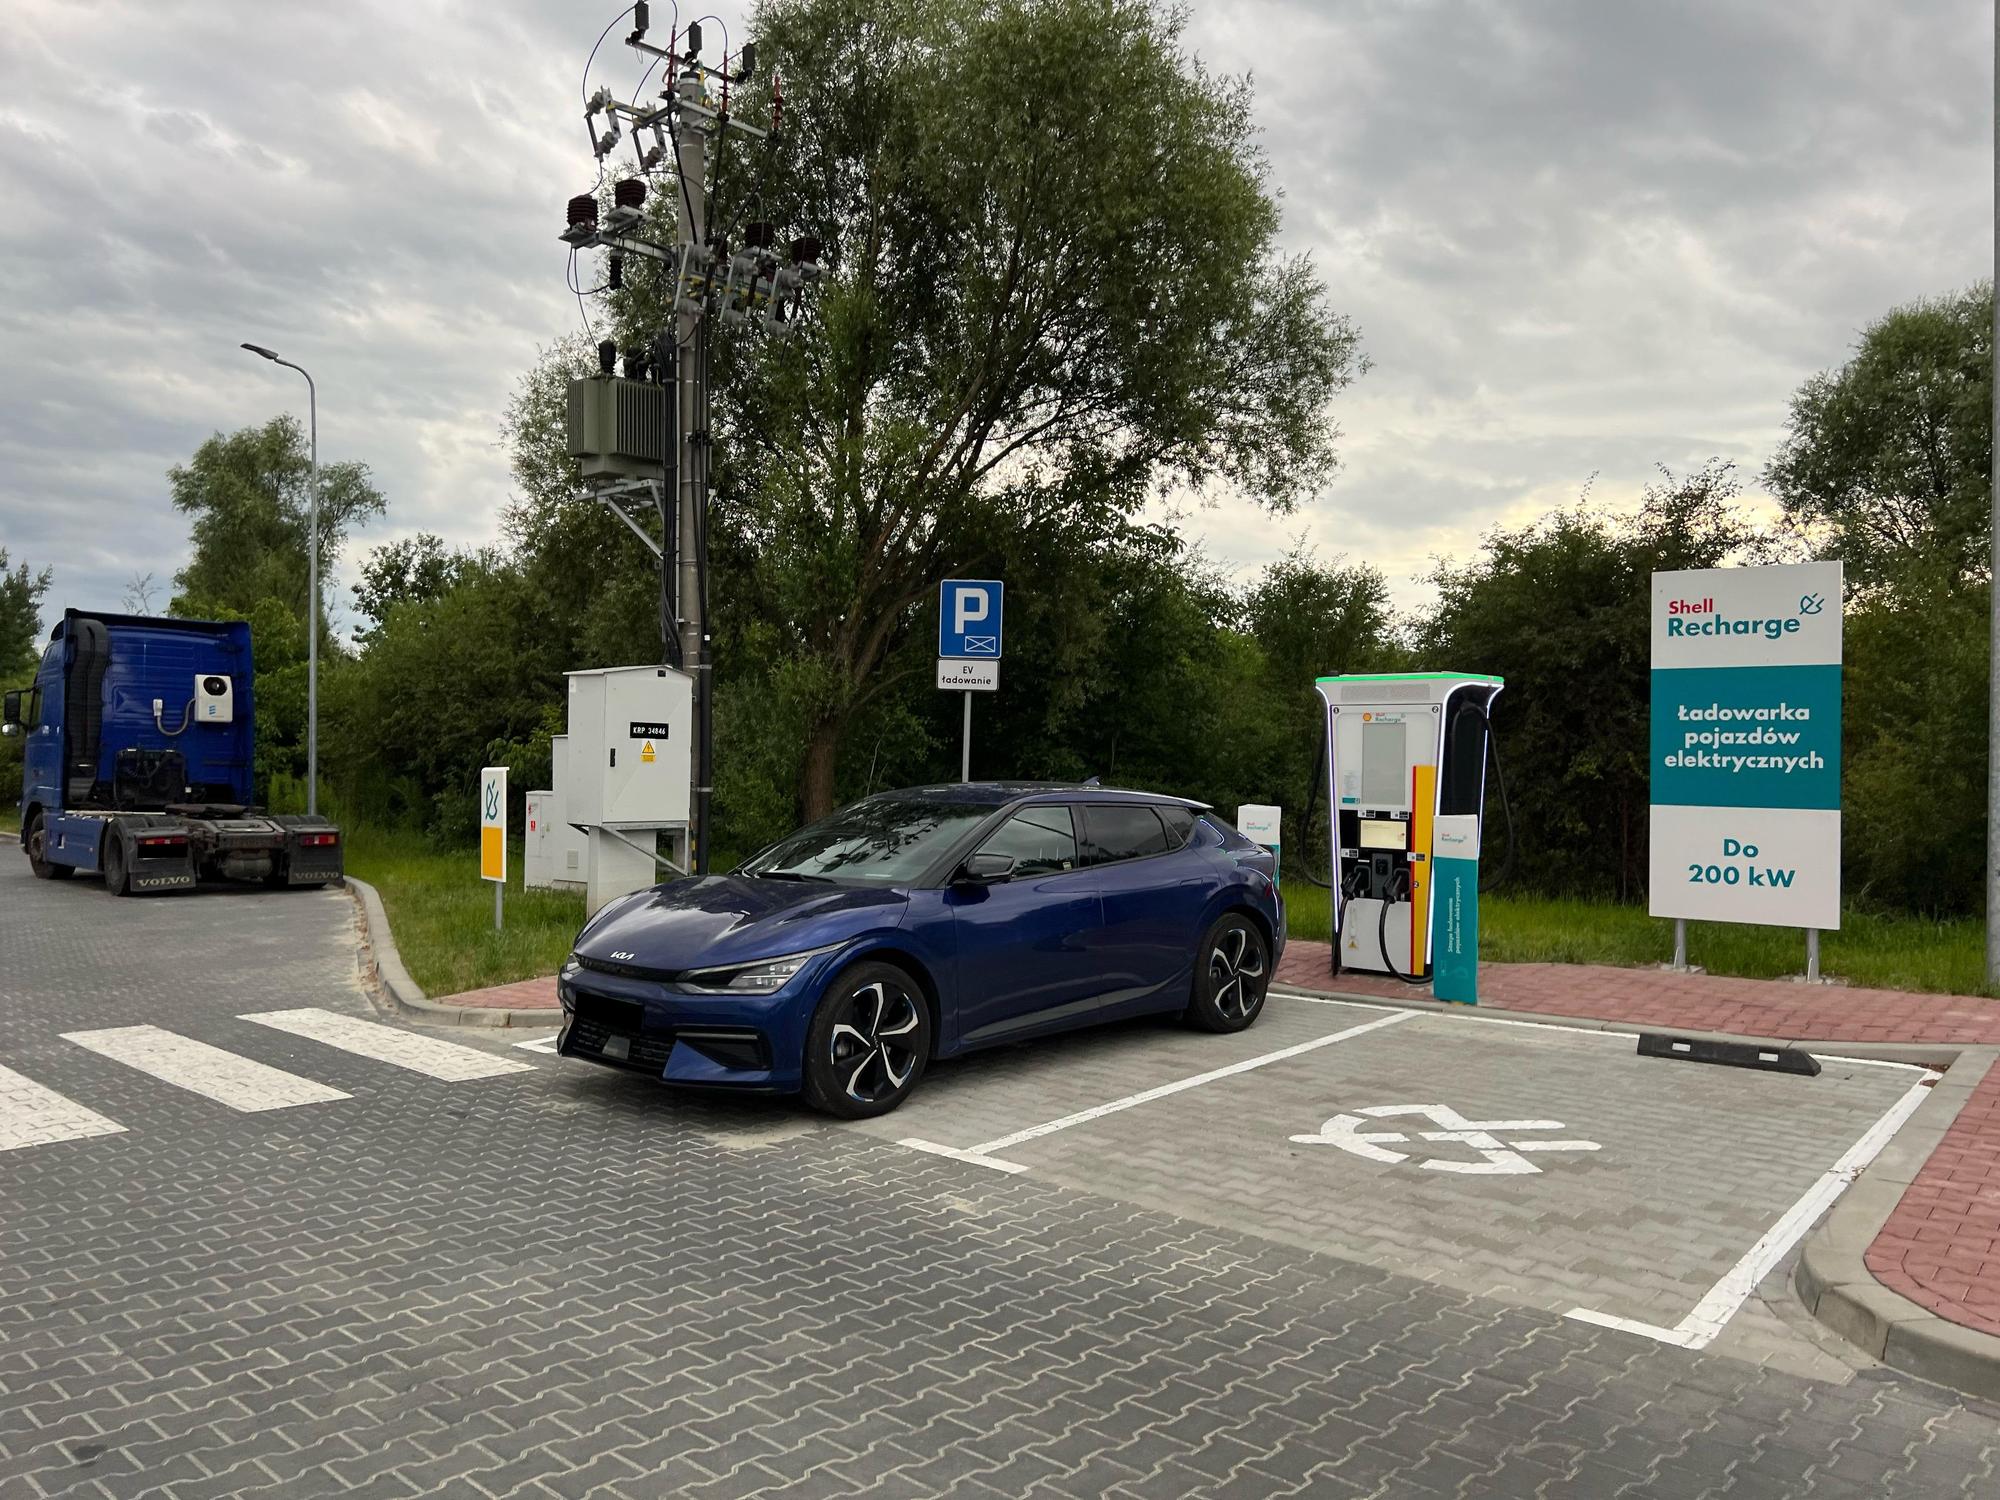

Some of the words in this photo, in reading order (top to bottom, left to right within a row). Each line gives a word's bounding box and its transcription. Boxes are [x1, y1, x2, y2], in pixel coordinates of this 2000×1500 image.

[954, 587, 989, 634] P
[1668, 598, 1713, 615] Shell
[1668, 614, 1800, 639] Recharge
[962, 666, 974, 674] EV
[942, 675, 992, 685] ładowanie
[1677, 702, 1810, 721] Ładowarka
[1684, 727, 1801, 749] pojazdów
[1664, 750, 1824, 773] elektrycznych
[1723, 838, 1759, 858] Do
[136, 875, 190, 887] VOLVO
[295, 871, 339, 880] VOLVO
[1688, 864, 1740, 885] 200
[1748, 866, 1796, 888] kW
[610, 951, 635, 960] KIA
